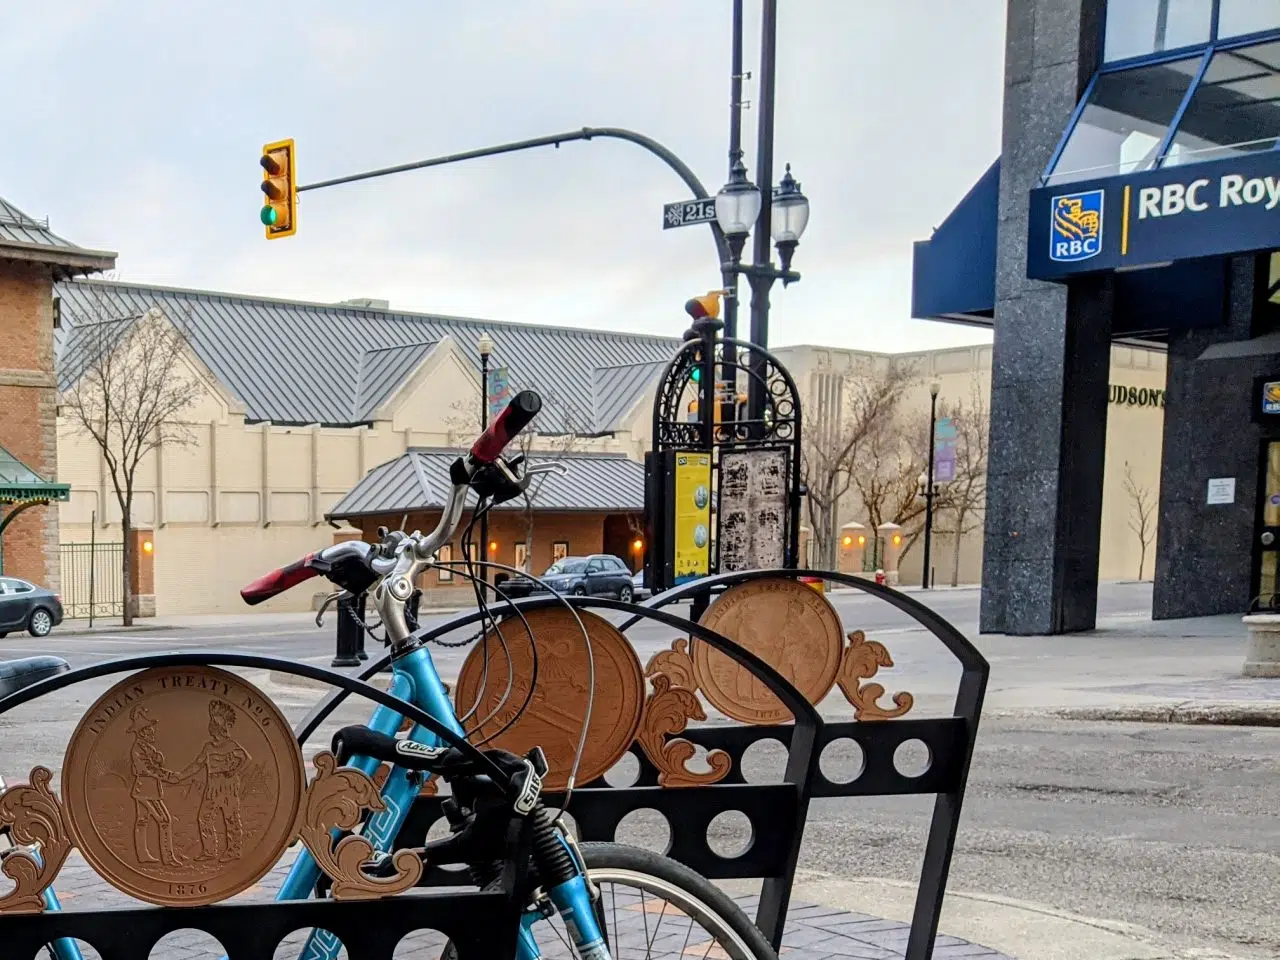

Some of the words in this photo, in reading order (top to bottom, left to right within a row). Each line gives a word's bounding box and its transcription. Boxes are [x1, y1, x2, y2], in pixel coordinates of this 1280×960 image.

[1138, 179, 1210, 220] RBC
[685, 202, 715, 221] 21s
[1055, 238, 1097, 257] RBC
[89, 684, 145, 734] INDIAN
[157, 675, 233, 695] TREATY
[168, 883, 208, 896] 1876
